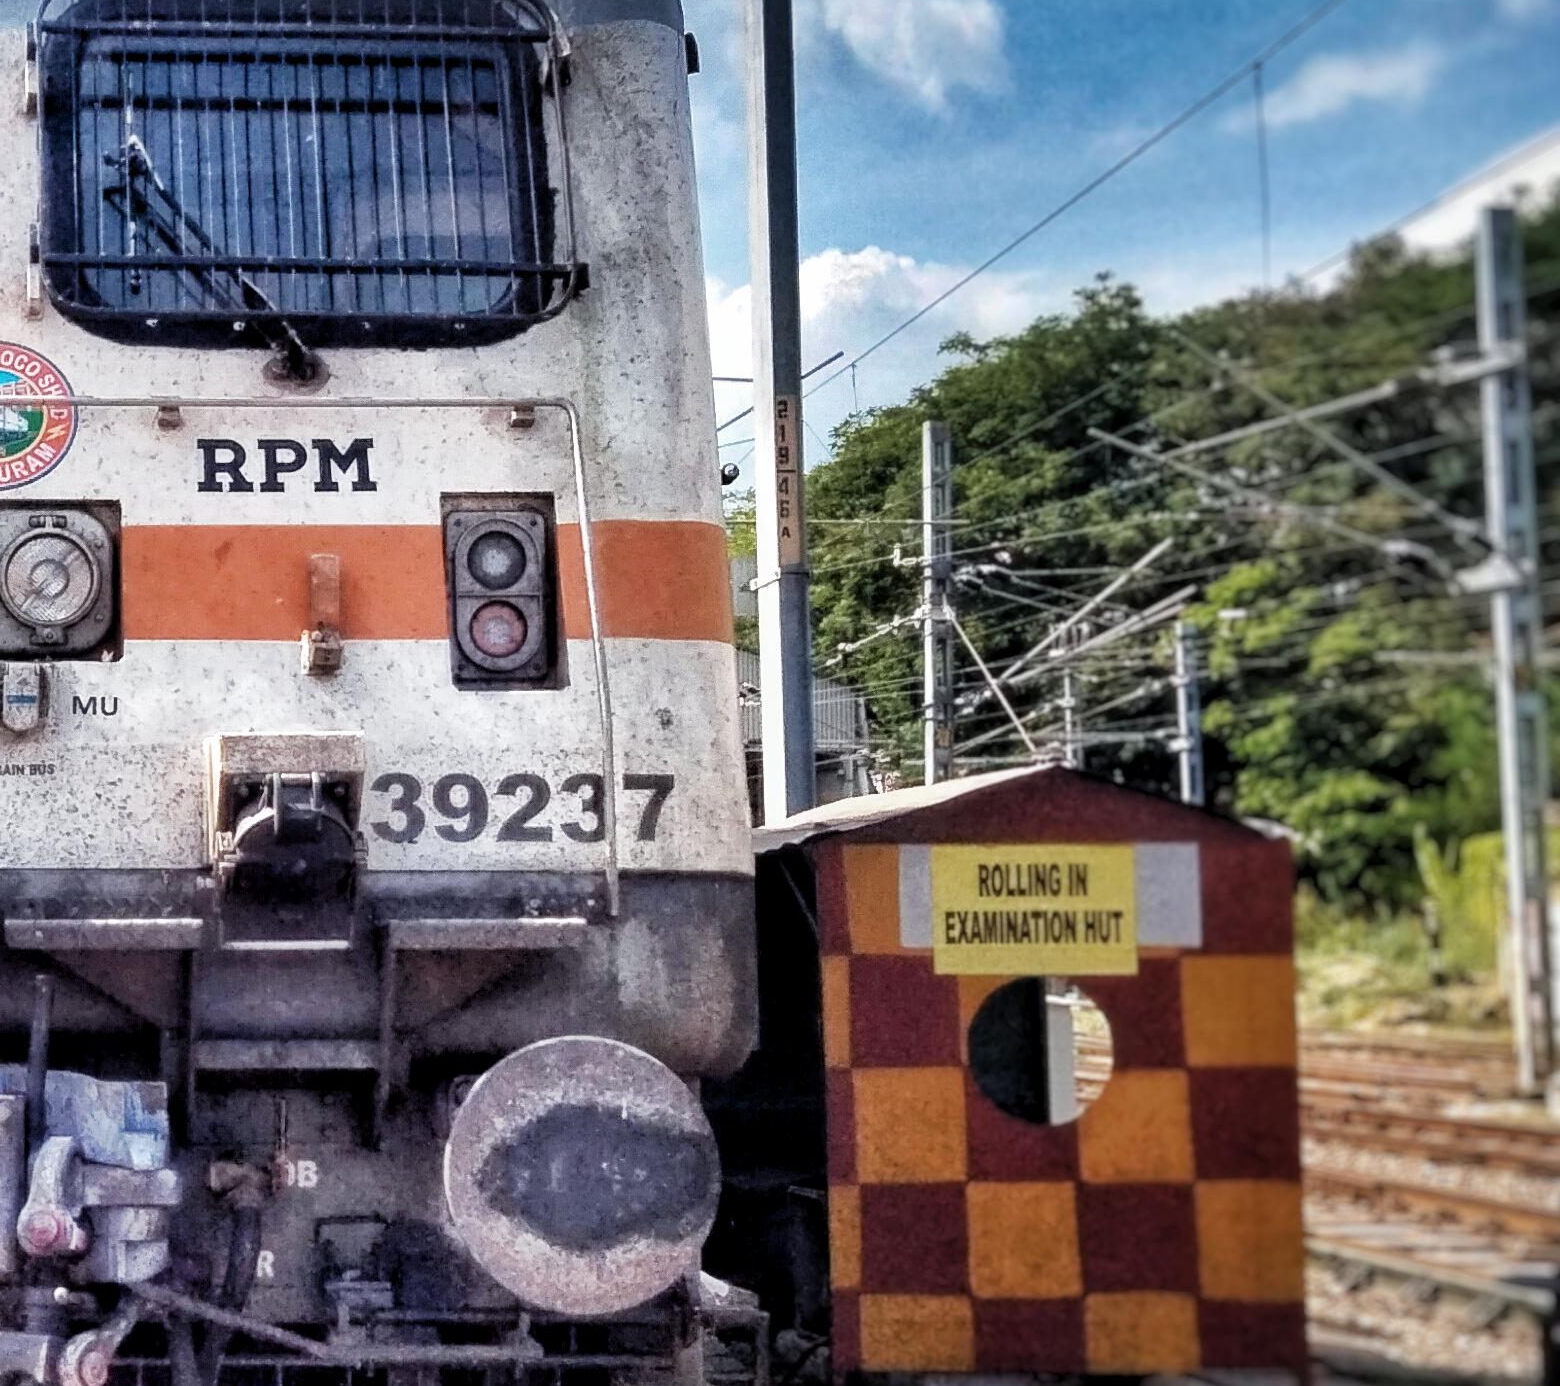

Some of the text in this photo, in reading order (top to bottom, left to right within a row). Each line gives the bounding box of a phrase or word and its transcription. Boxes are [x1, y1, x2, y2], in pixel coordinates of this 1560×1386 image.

[38, 373, 69, 420] SHD
[197, 438, 378, 493] RPM
[72, 695, 119, 716] MU
[28, 763, 56, 776] BUS
[370, 772, 675, 843] 39237
[978, 863, 1088, 897] ROLLING IN
[945, 911, 1123, 944] EXAMINATION HUT
